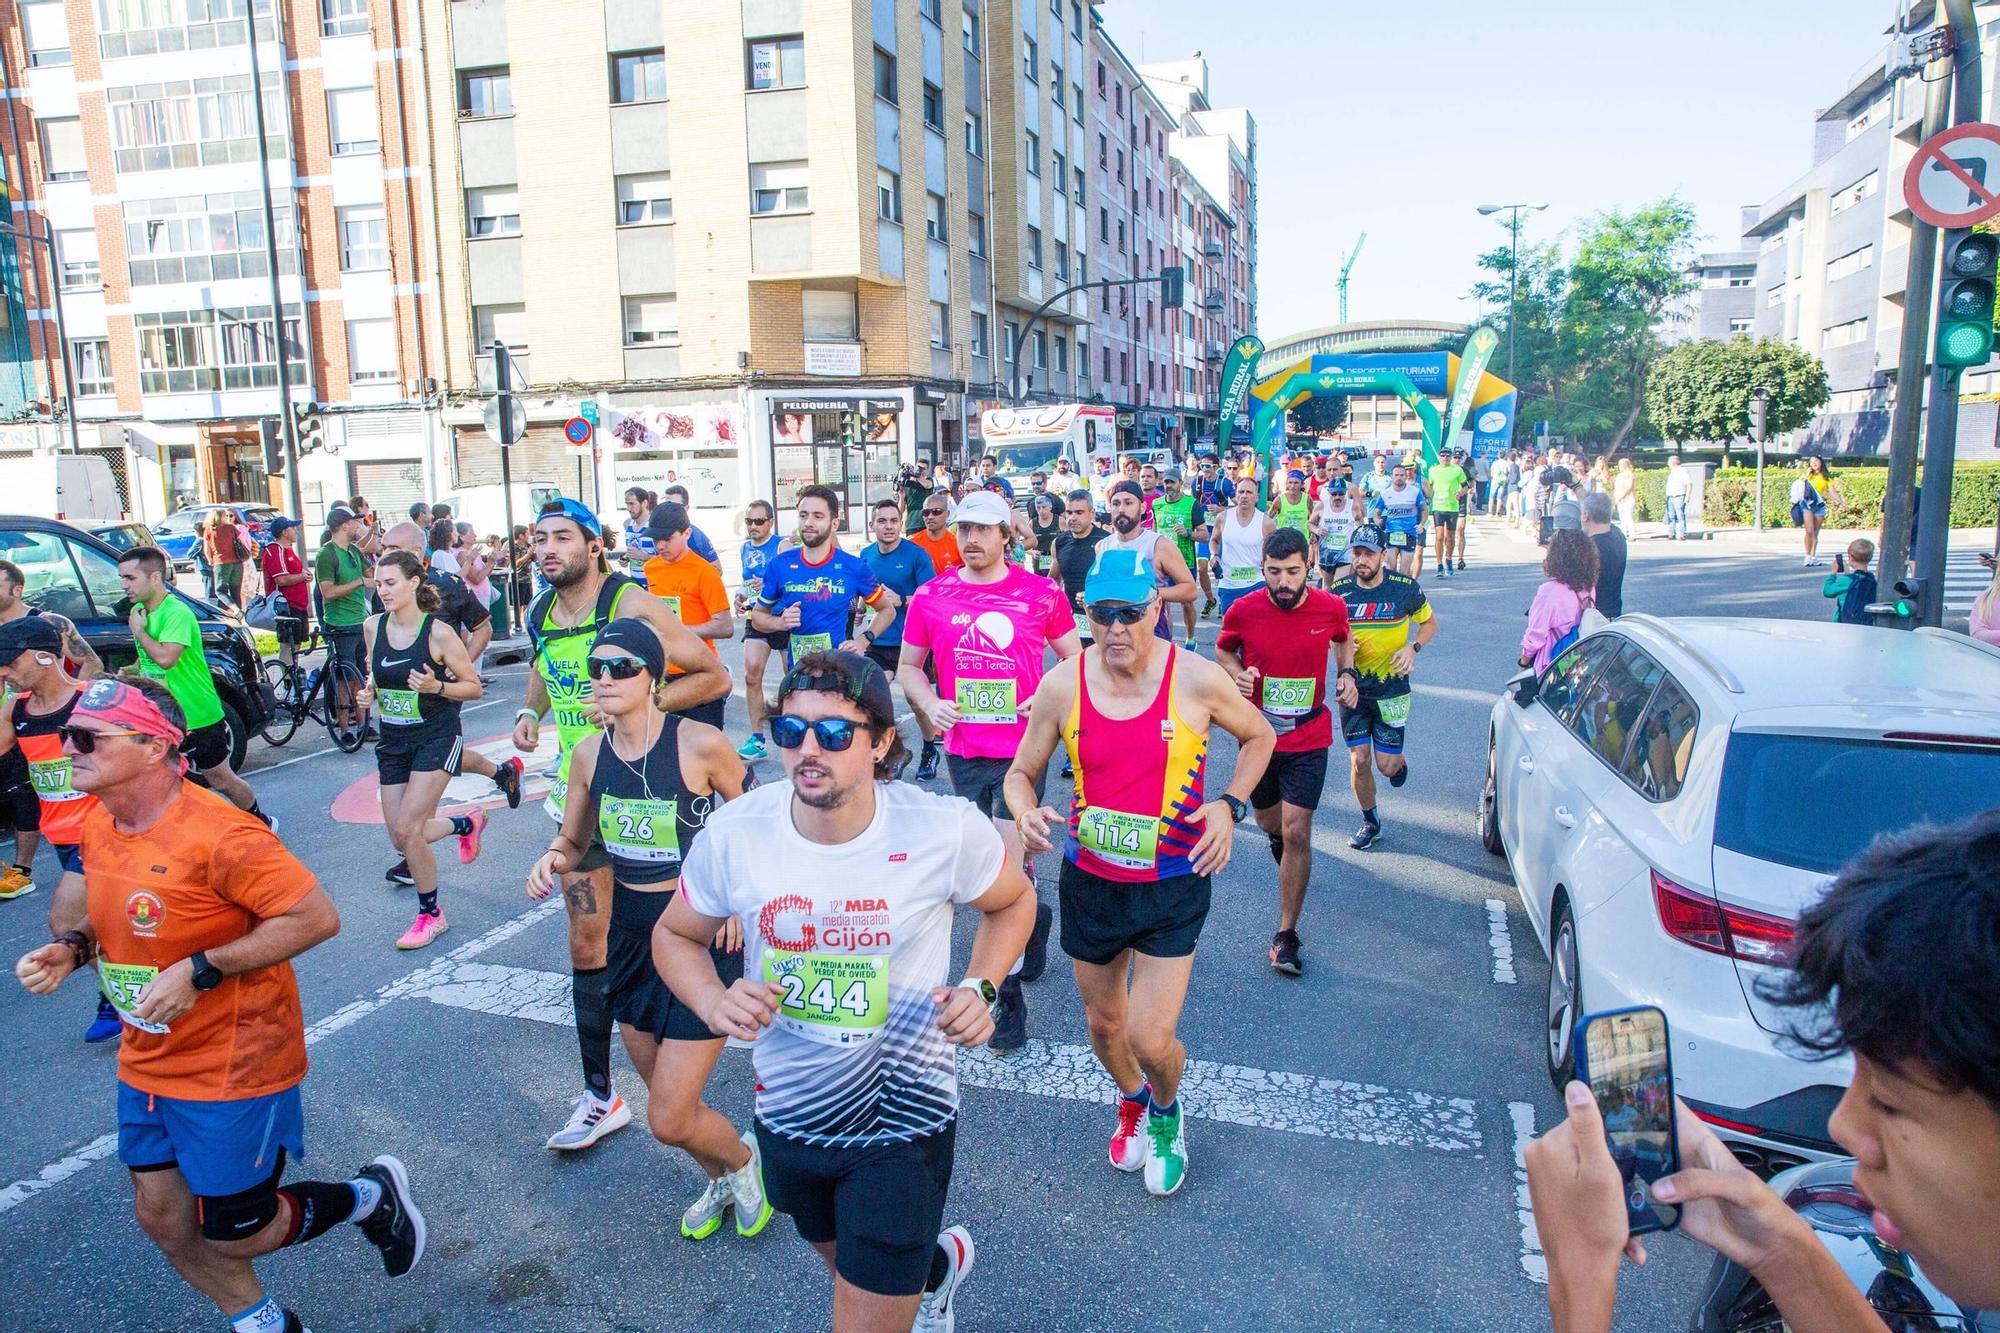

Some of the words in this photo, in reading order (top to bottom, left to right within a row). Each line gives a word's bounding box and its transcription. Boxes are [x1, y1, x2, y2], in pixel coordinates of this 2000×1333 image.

[1220, 397, 1236, 421] CAJA
[1228, 361, 1251, 396] RURAL
[1235, 372, 1252, 405] ASTURIAS
[783, 401, 849, 410] PELUQUERÍA
[877, 401, 897, 409] SEX
[1231, 403, 1240, 414] DE
[951, 612, 972, 627] edp
[956, 661, 969, 670] de
[972, 660, 982, 670] la
[986, 660, 1016, 671] Tercia
[967, 690, 1006, 709] 186
[1269, 687, 1310, 702] 207
[383, 698, 412, 714] 254
[1387, 703, 1407, 717] 119
[34, 768, 67, 788] 217
[617, 814, 654, 840] 26
[1094, 822, 1140, 852] 114
[844, 899, 888, 913] MBA
[822, 912, 850, 926] media
[852, 912, 890, 926] maratón
[822, 927, 891, 951] Gijón
[811, 959, 819, 967] IV
[820, 960, 842, 969] MEDIA
[814, 967, 835, 976] VERDE
[837, 969, 846, 977] DE
[849, 970, 877, 979] OVIEDO
[780, 973, 870, 1016] 244
